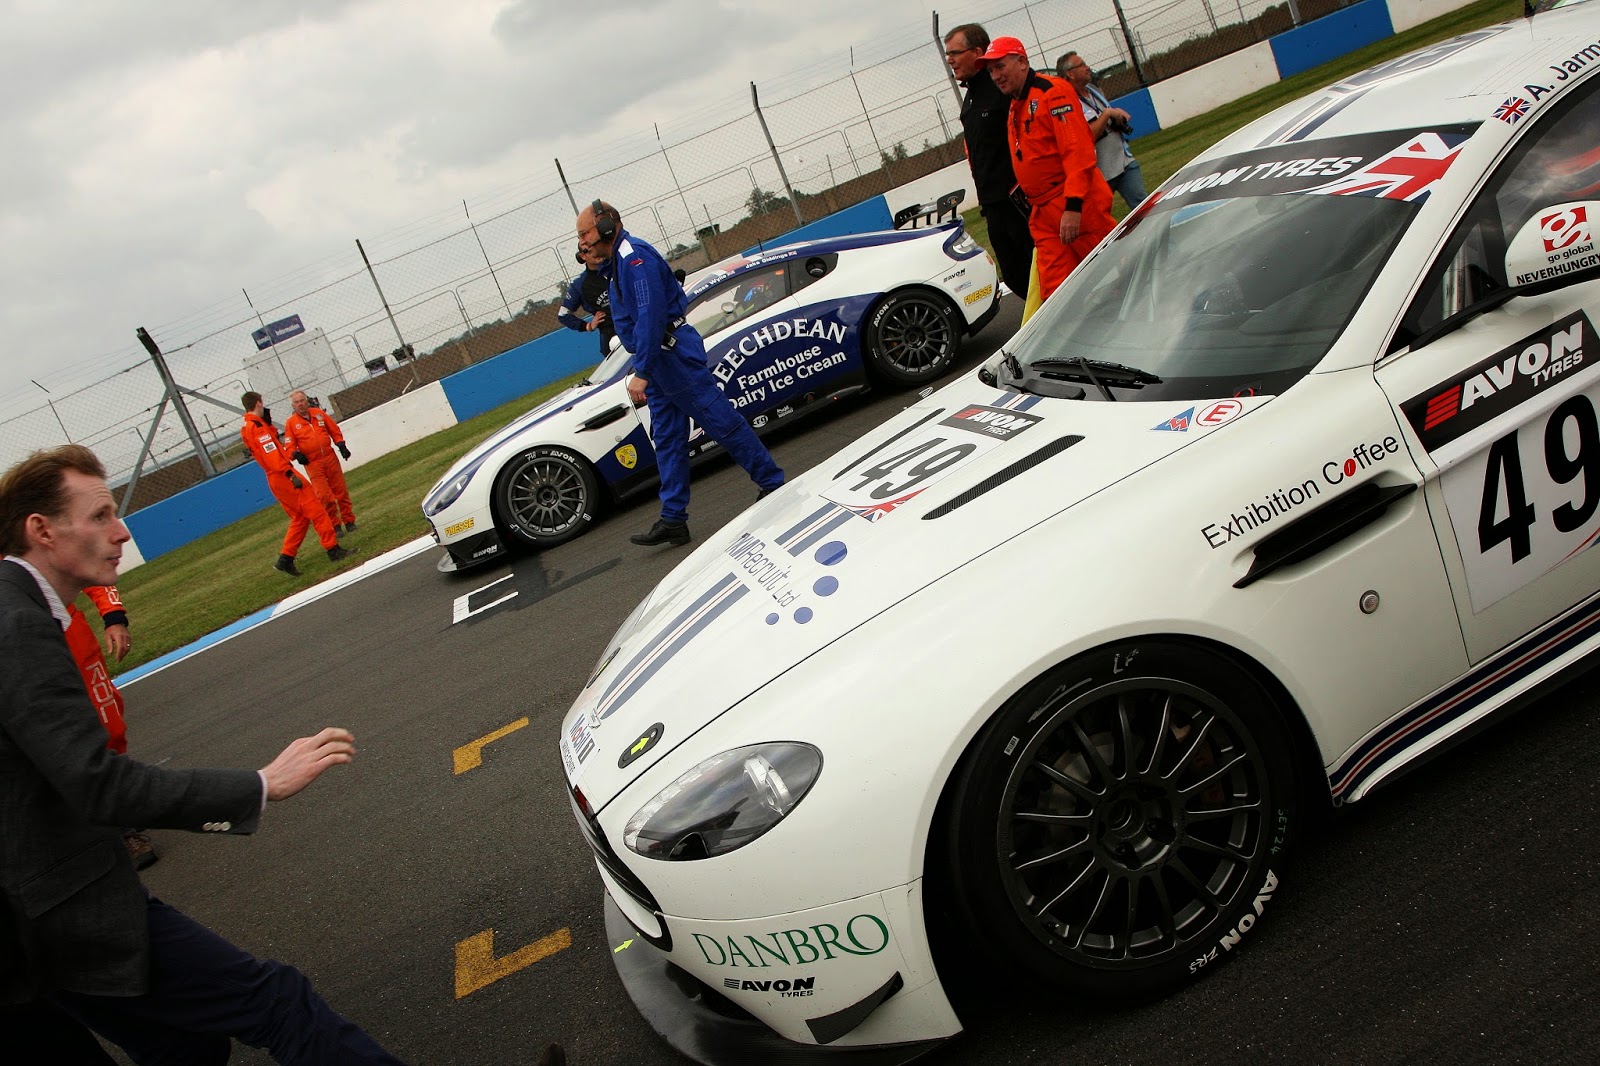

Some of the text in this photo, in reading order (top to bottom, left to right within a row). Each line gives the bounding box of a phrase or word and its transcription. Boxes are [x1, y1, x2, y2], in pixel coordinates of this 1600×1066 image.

[1549, 38, 1600, 81] Jarm
[1162, 156, 1363, 201] AVON TYRES
[1516, 252, 1600, 285] NEVERHUNGRY
[1548, 242, 1594, 264] go global
[947, 267, 966, 280] AVON
[963, 283, 993, 306] FINESSE
[873, 304, 890, 327] AVON
[712, 318, 847, 391] EECHDEAN
[737, 345, 822, 390] Farmhouse
[768, 375, 794, 393] Ice
[796, 351, 847, 379] Cream
[1461, 320, 1583, 411] AVON
[1532, 349, 1583, 388] TYRES
[965, 410, 1036, 431] AVON
[550, 450, 576, 464] AVON
[849, 437, 978, 500] 49
[1201, 436, 1399, 550] Exhibition Coffee
[1477, 394, 1600, 566] 49
[444, 516, 475, 537] FINESSE
[478, 544, 498, 556] AVON
[772, 582, 802, 608] Ltd
[569, 713, 591, 755] Mobil
[1278, 808, 1289, 834] SET
[1219, 868, 1279, 952] AVON
[690, 913, 890, 968] DANBRO
[741, 976, 816, 992] AVON
[780, 990, 814, 998] TYRES
